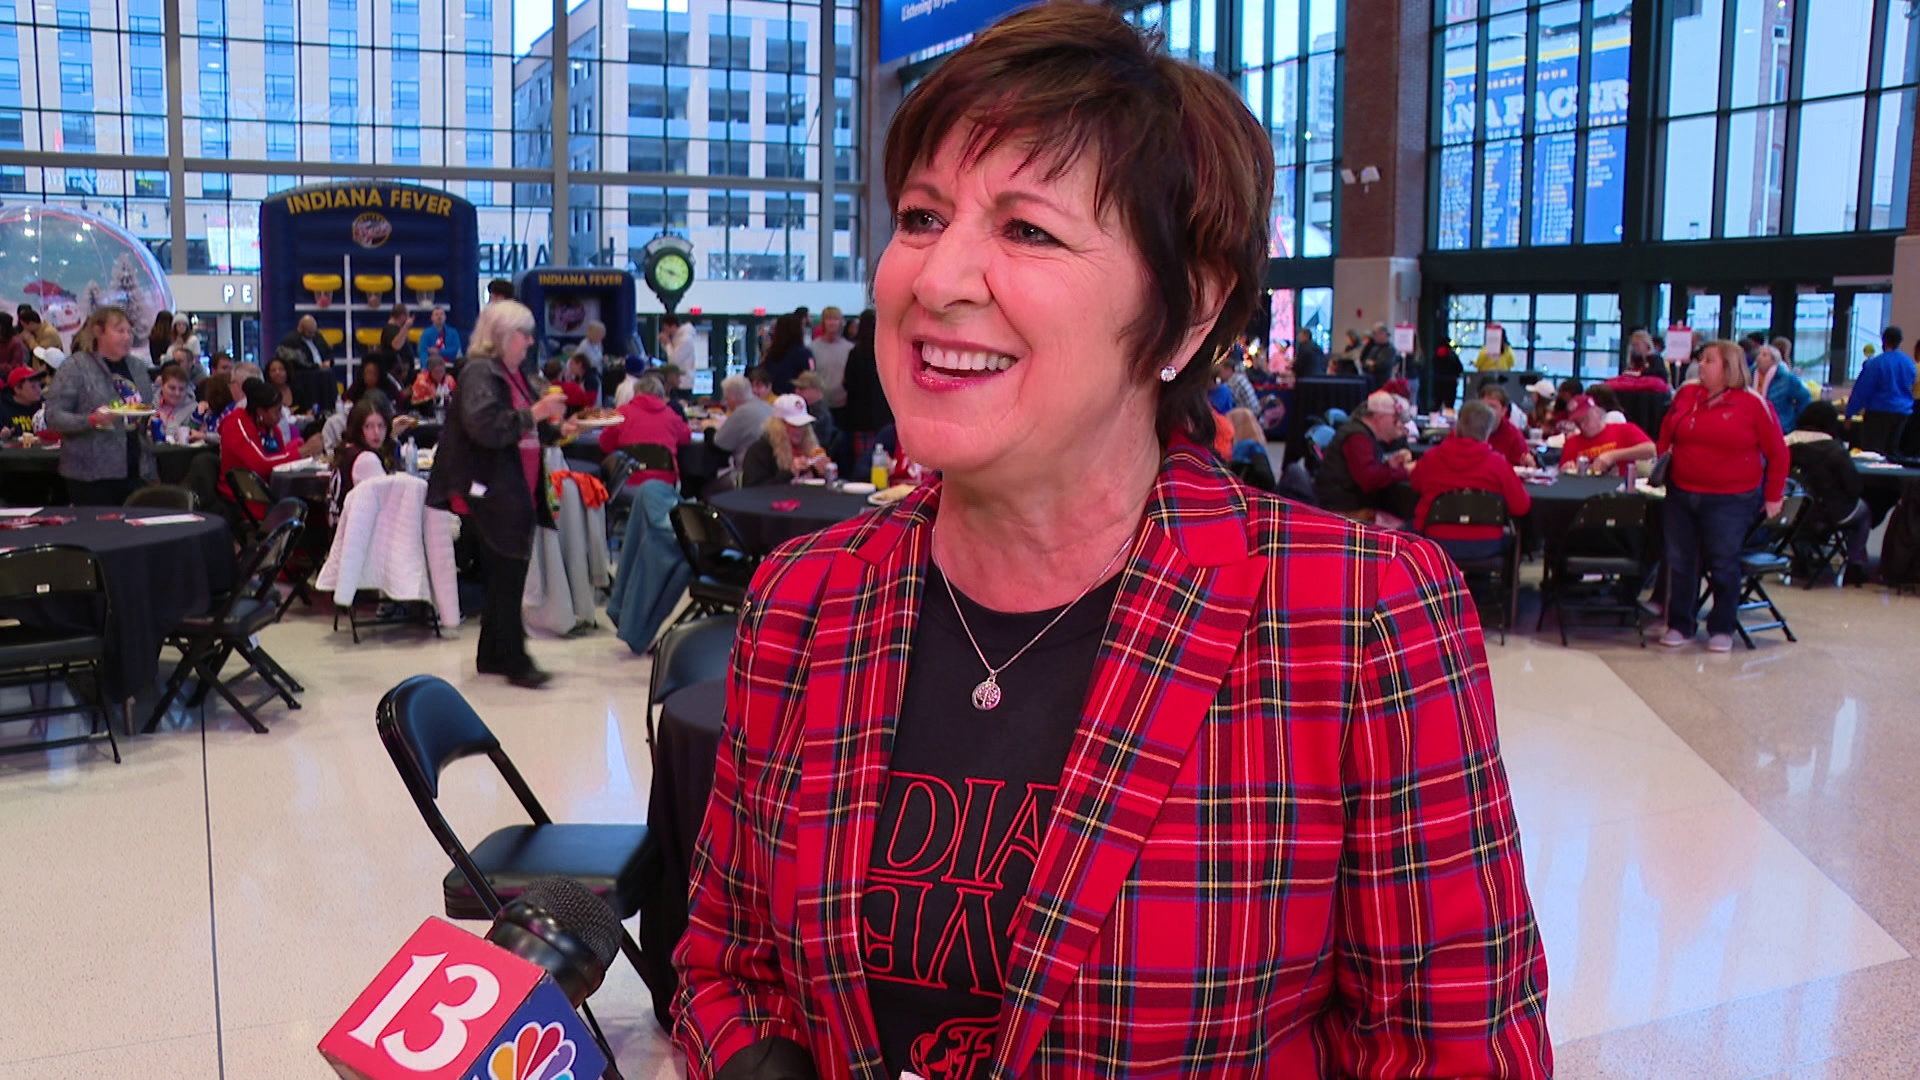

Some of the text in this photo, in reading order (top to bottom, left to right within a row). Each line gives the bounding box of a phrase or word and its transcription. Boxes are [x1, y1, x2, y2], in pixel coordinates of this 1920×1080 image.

[286, 187, 452, 217] INDIANA FEVER
[538, 274, 623, 286] INDIANA FEVER
[347, 952, 500, 1073] 13
